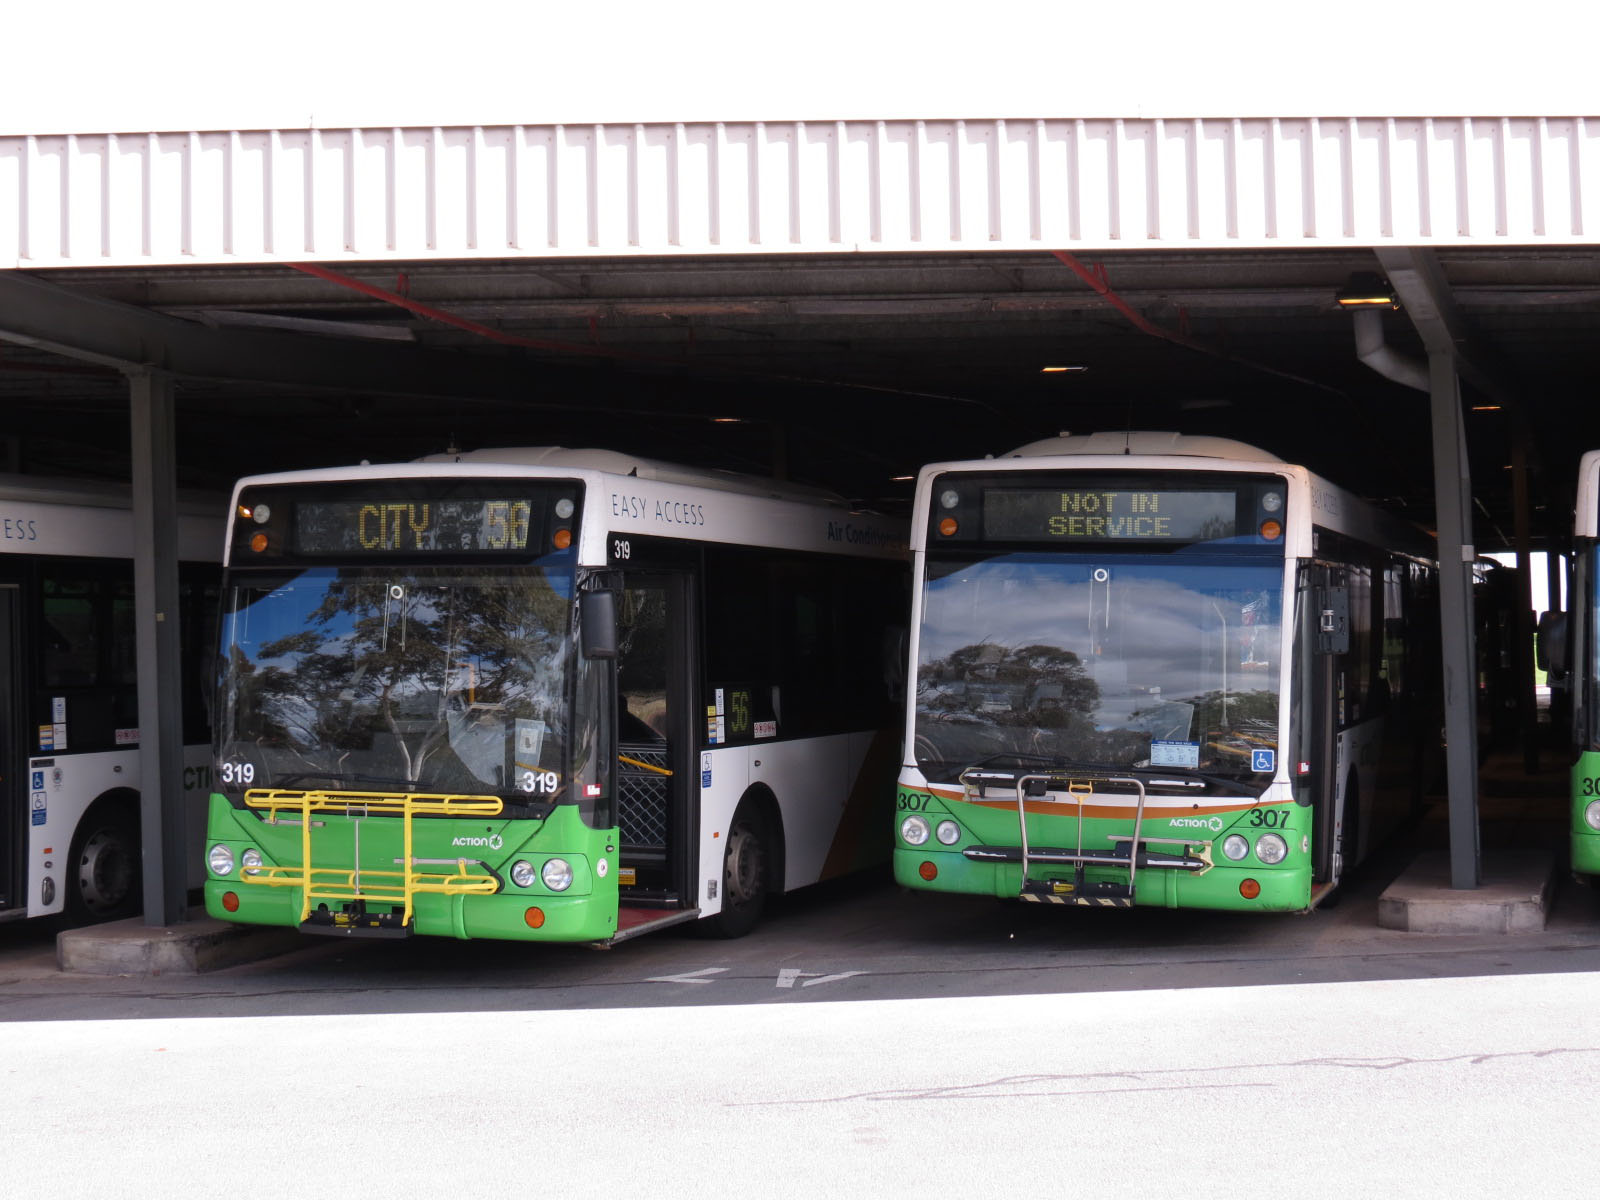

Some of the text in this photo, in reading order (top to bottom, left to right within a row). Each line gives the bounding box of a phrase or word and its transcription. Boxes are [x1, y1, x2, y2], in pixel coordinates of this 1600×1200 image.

[612, 494, 704, 526] EASY ACCESS
[1061, 493, 1158, 513] NOT IN
[4, 519, 37, 541] ESS
[359, 502, 531, 549] CITY 56
[827, 521, 843, 541] Air
[1048, 516, 1171, 536] SERVICE
[614, 540, 631, 560] 319
[731, 691, 749, 732] 56
[183, 766, 213, 791] CTI
[222, 763, 255, 783] 319
[523, 771, 558, 793] 319
[898, 792, 932, 812] 307
[1169, 818, 1207, 828] ACTION
[1250, 809, 1291, 828] 307
[452, 837, 488, 847] ACTION
